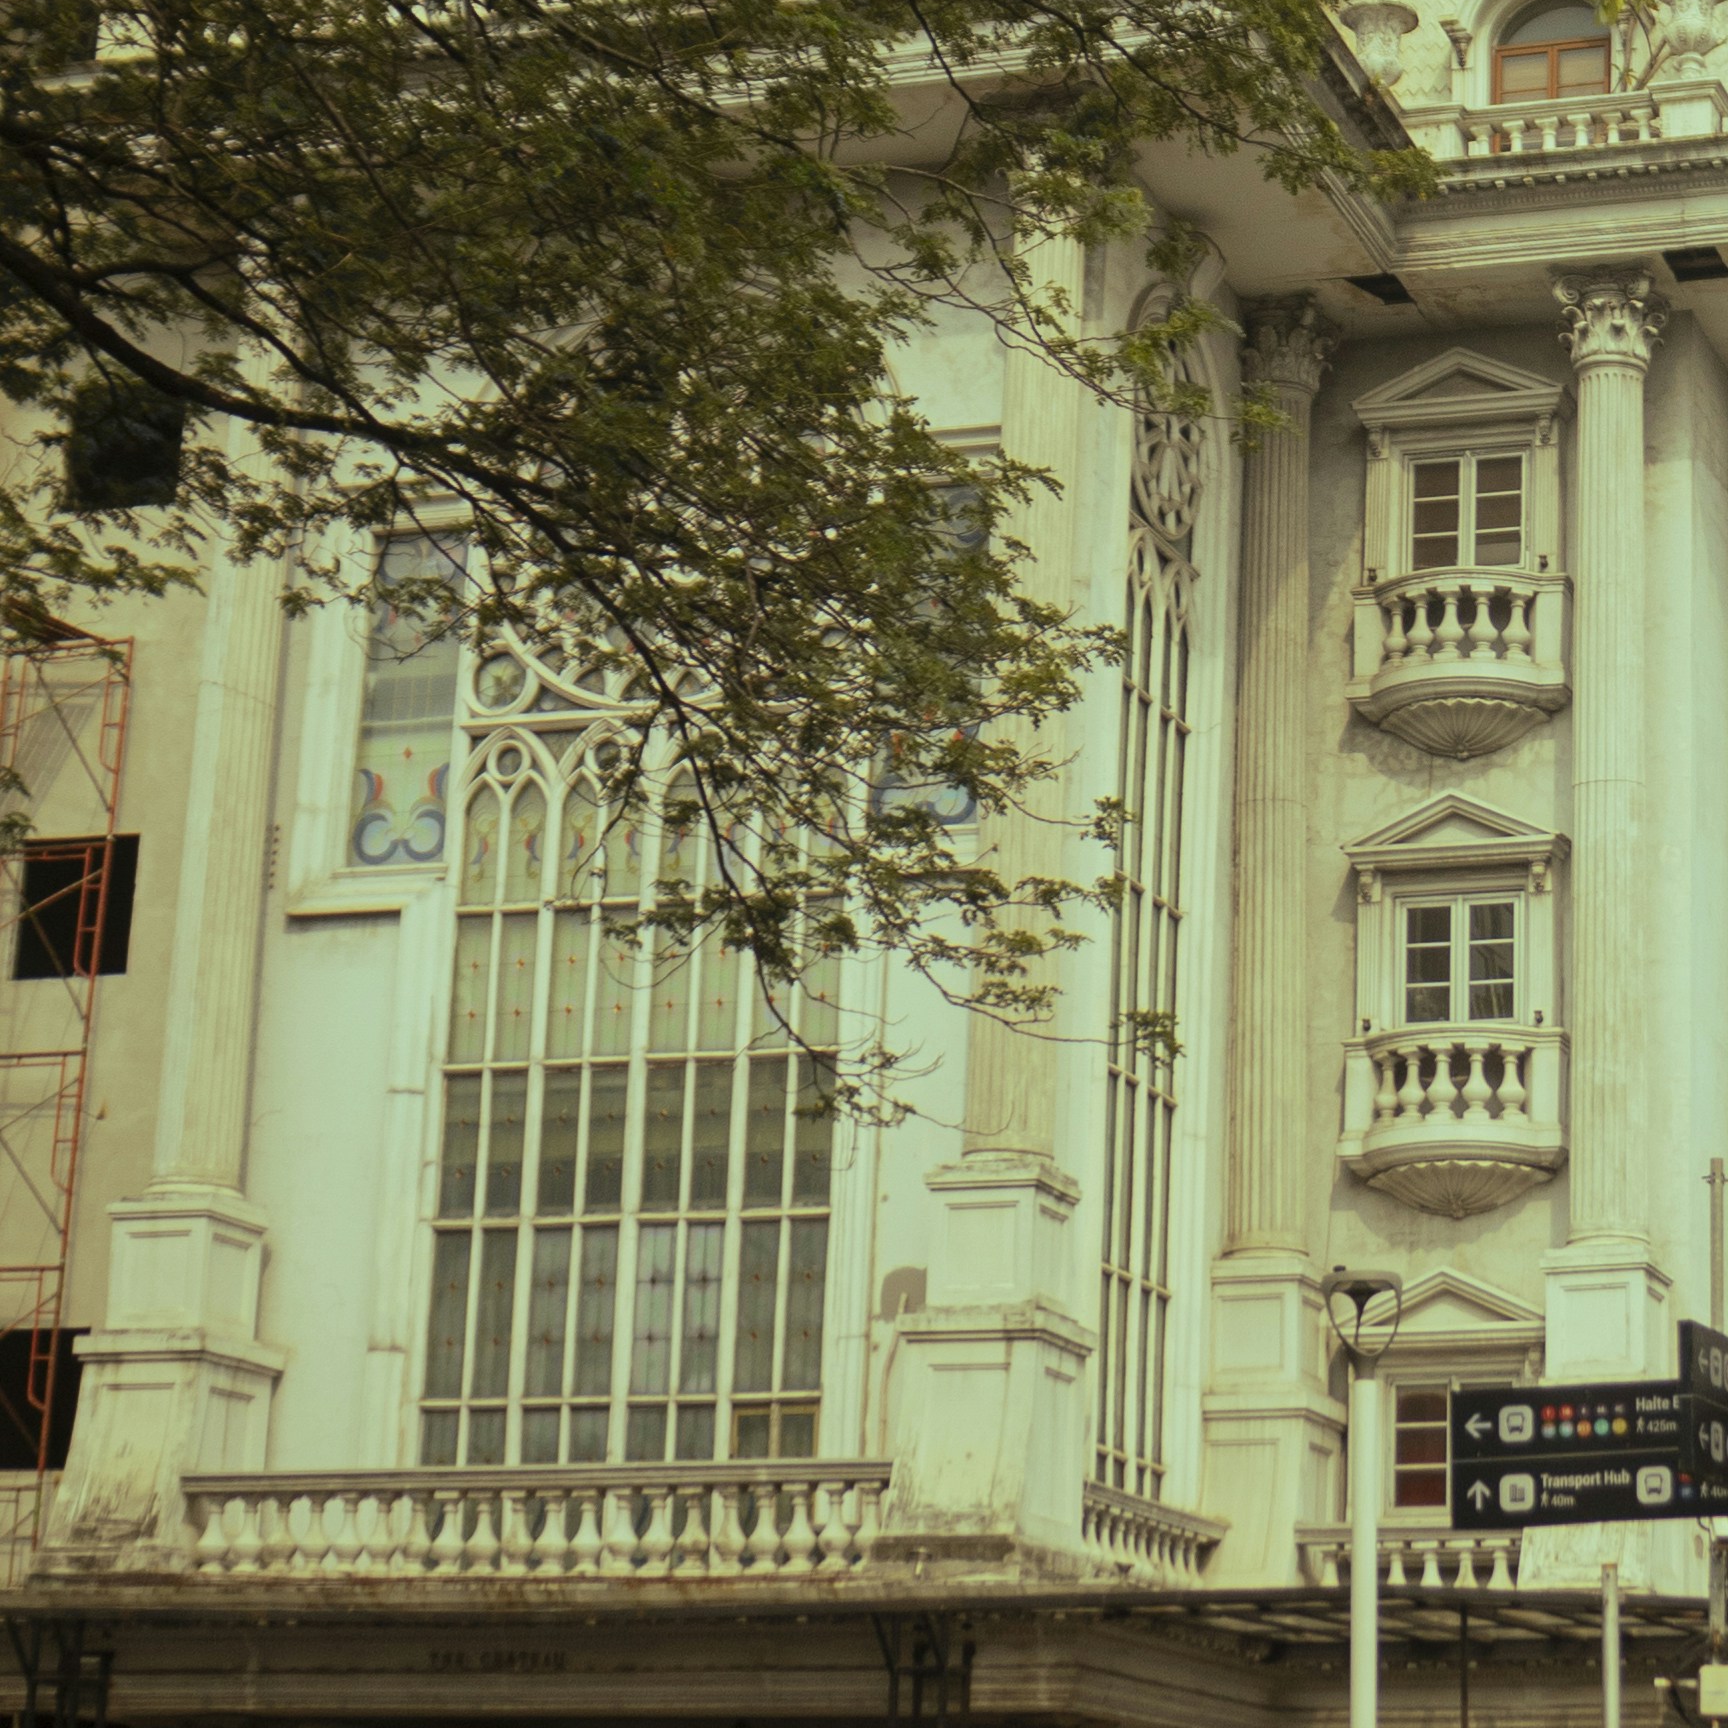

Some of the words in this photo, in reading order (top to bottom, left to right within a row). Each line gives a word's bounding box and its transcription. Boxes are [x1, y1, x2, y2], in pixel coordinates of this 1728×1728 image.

[1636, 1396, 1670, 1412] Halte
[1647, 1420, 1677, 1432] 425m
[1540, 1472, 1600, 1490] Transport
[1603, 1468, 1630, 1485] Hub
[1551, 1494, 1576, 1506] 40m
